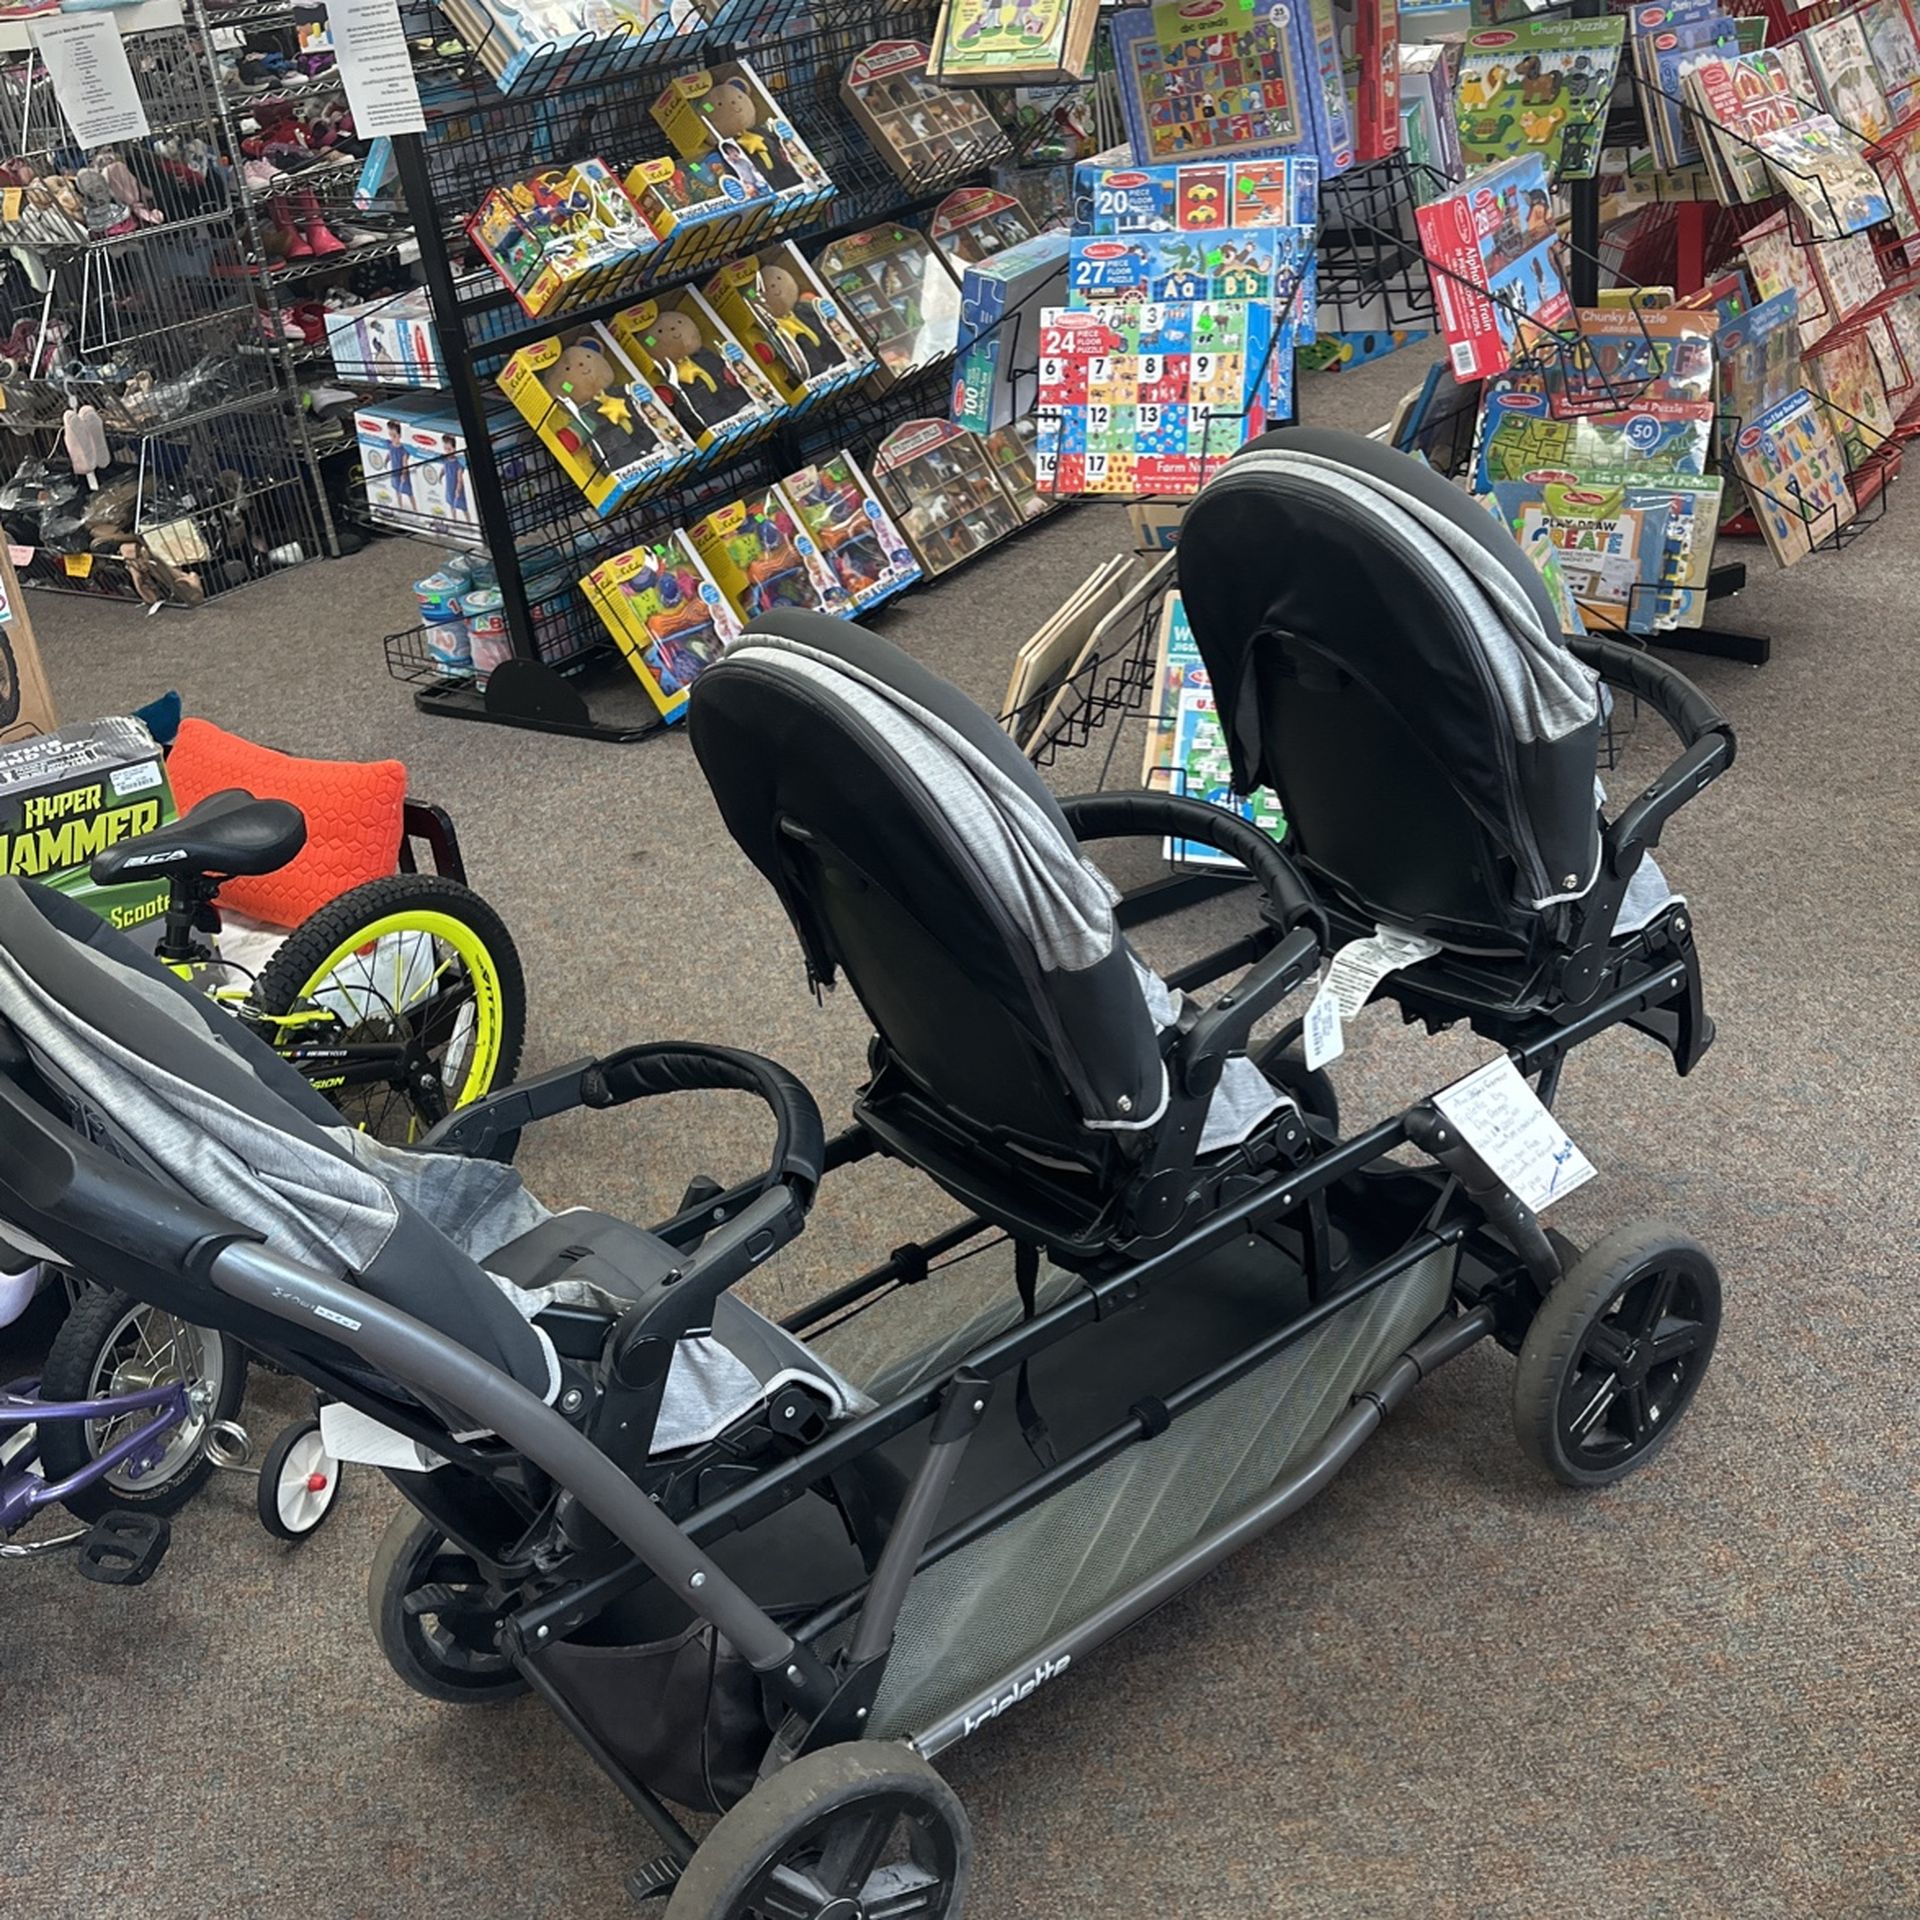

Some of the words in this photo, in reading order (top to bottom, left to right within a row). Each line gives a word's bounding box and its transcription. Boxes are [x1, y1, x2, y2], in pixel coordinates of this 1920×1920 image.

[1572, 19, 1608, 32] Puzzle
[1100, 190, 1128, 214] 20
[1076, 261, 1105, 285] 27
[1147, 307, 1157, 323] 3
[1480, 301, 1492, 331] Train
[1581, 310, 1626, 325] Chunky
[1046, 331, 1076, 354] 24
[1045, 360, 1056, 375] 6
[1095, 359, 1104, 374] 7
[1145, 358, 1156, 373] 8
[1197, 357, 1208, 372] 9
[963, 387, 978, 415] 100
[1651, 402, 1684, 414] Puzzle
[1091, 407, 1107, 423] 12
[1140, 407, 1158, 422] 13
[1192, 406, 1210, 422] 14
[712, 419, 737, 436] Teddy
[736, 411, 757, 425] Wear
[1633, 424, 1653, 440] 50
[615, 464, 643, 481] Teddy
[641, 455, 664, 469] Wear
[1040, 456, 1057, 471] 16
[1088, 456, 1105, 471] 17
[1156, 461, 1186, 472] Farm
[24, 784, 102, 829] HYPER
[964, 1654, 1071, 1737] triplette
